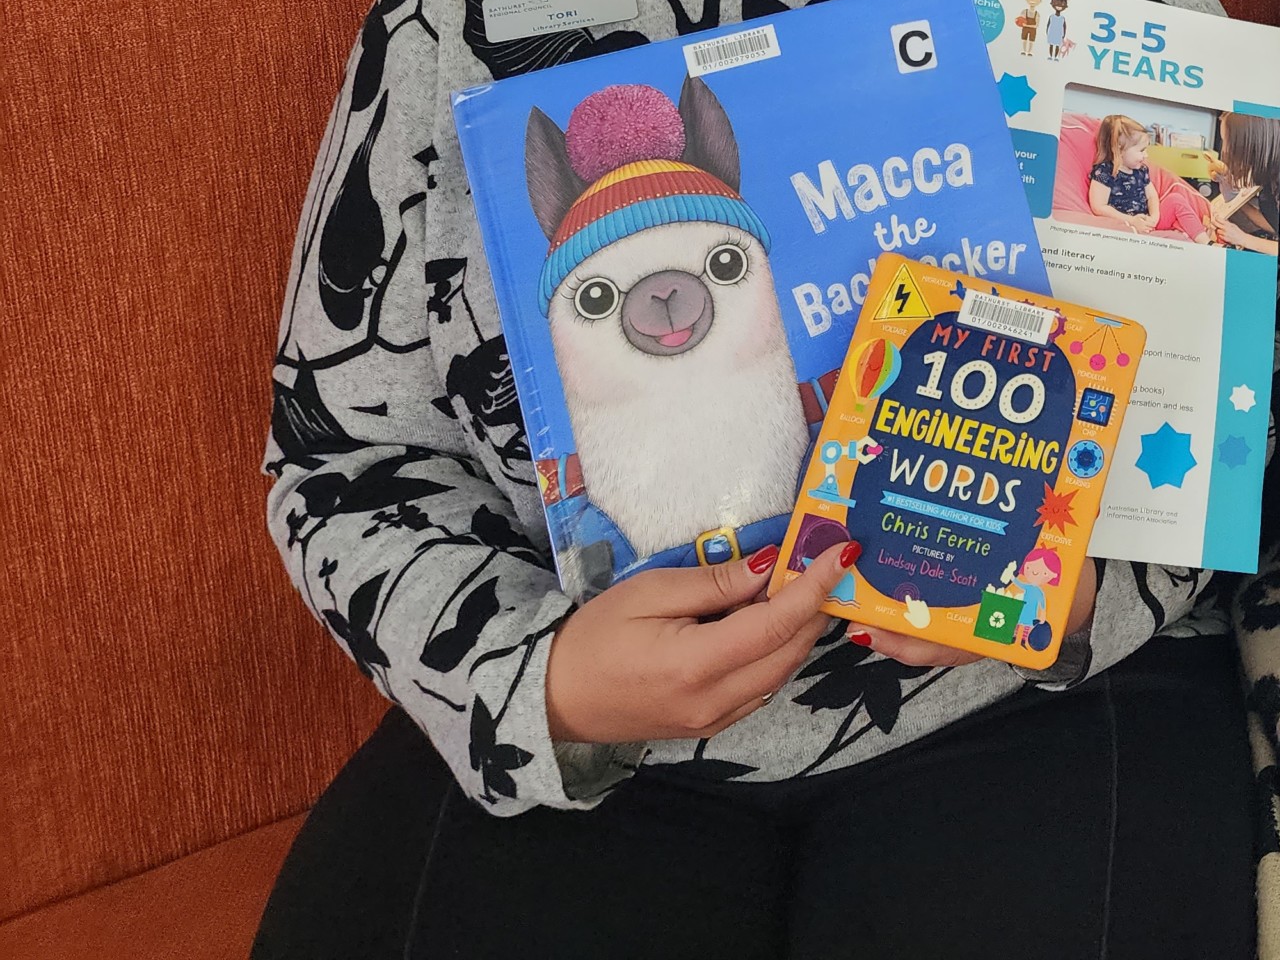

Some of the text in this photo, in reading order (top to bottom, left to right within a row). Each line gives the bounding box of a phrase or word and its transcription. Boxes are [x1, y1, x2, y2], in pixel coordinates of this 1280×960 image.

[547, 10, 577, 20] TORI
[693, 29, 765, 51] BATHURST LIBRARY
[1090, 12, 1166, 53] 3-5
[899, 30, 932, 67] C
[703, 50, 766, 71] 01/002979053
[1088, 45, 1204, 89] YEARS
[790, 143, 974, 235] Macca
[873, 214, 936, 251] the
[1062, 249, 1095, 261] literacy
[1075, 265, 1153, 283] while reading story
[792, 238, 1026, 337] Baccker
[975, 294, 1045, 317] BATHURST LIBRARY
[881, 324, 908, 337] VOLTAGE
[971, 317, 1033, 338] 01/002946241
[930, 323, 1055, 372] MY FIRST
[1165, 351, 1200, 362] interaction
[915, 350, 1046, 424] 100
[1140, 385, 1165, 396] books)
[1180, 404, 1193, 412] less
[875, 399, 1061, 474] ENGINEERING
[1082, 428, 1097, 437] CHIP
[889, 447, 1022, 512] WORDS
[1065, 476, 1091, 489] BEARING
[1107, 512, 1145, 521] Information
[881, 512, 991, 556] Chris Ferrie
[912, 545, 944, 559] PICTURES
[878, 549, 977, 587] Lindsay Dale Scott
[875, 605, 897, 615] HAPTIC
